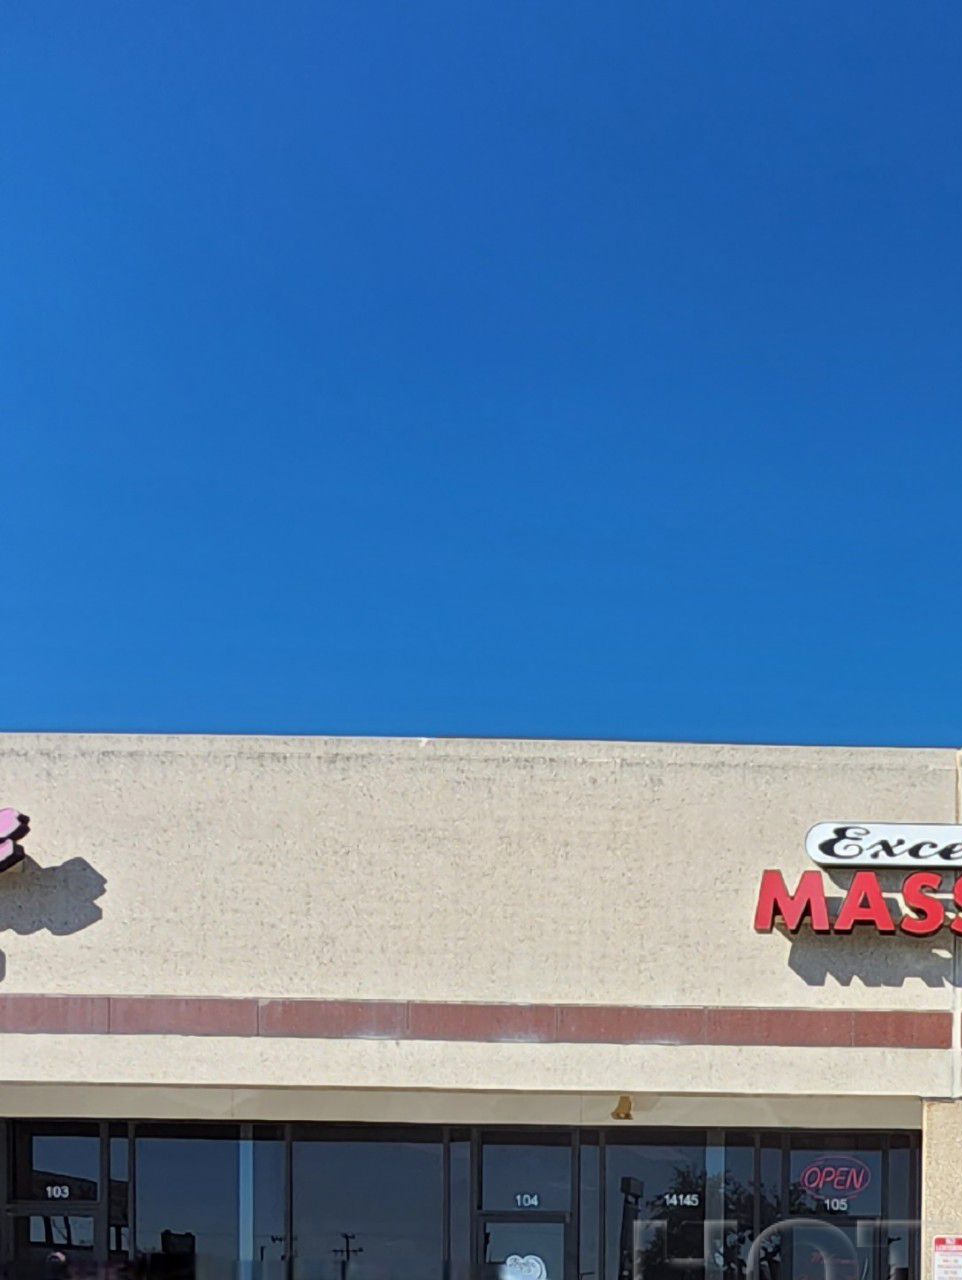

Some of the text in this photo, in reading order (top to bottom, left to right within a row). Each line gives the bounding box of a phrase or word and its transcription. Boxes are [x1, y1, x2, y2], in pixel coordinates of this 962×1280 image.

[803, 1167, 865, 1190] OPEN
[46, 1186, 70, 1199] 103
[515, 1194, 539, 1207] 104
[663, 1193, 699, 1207] 14145
[824, 1199, 848, 1211] 105
